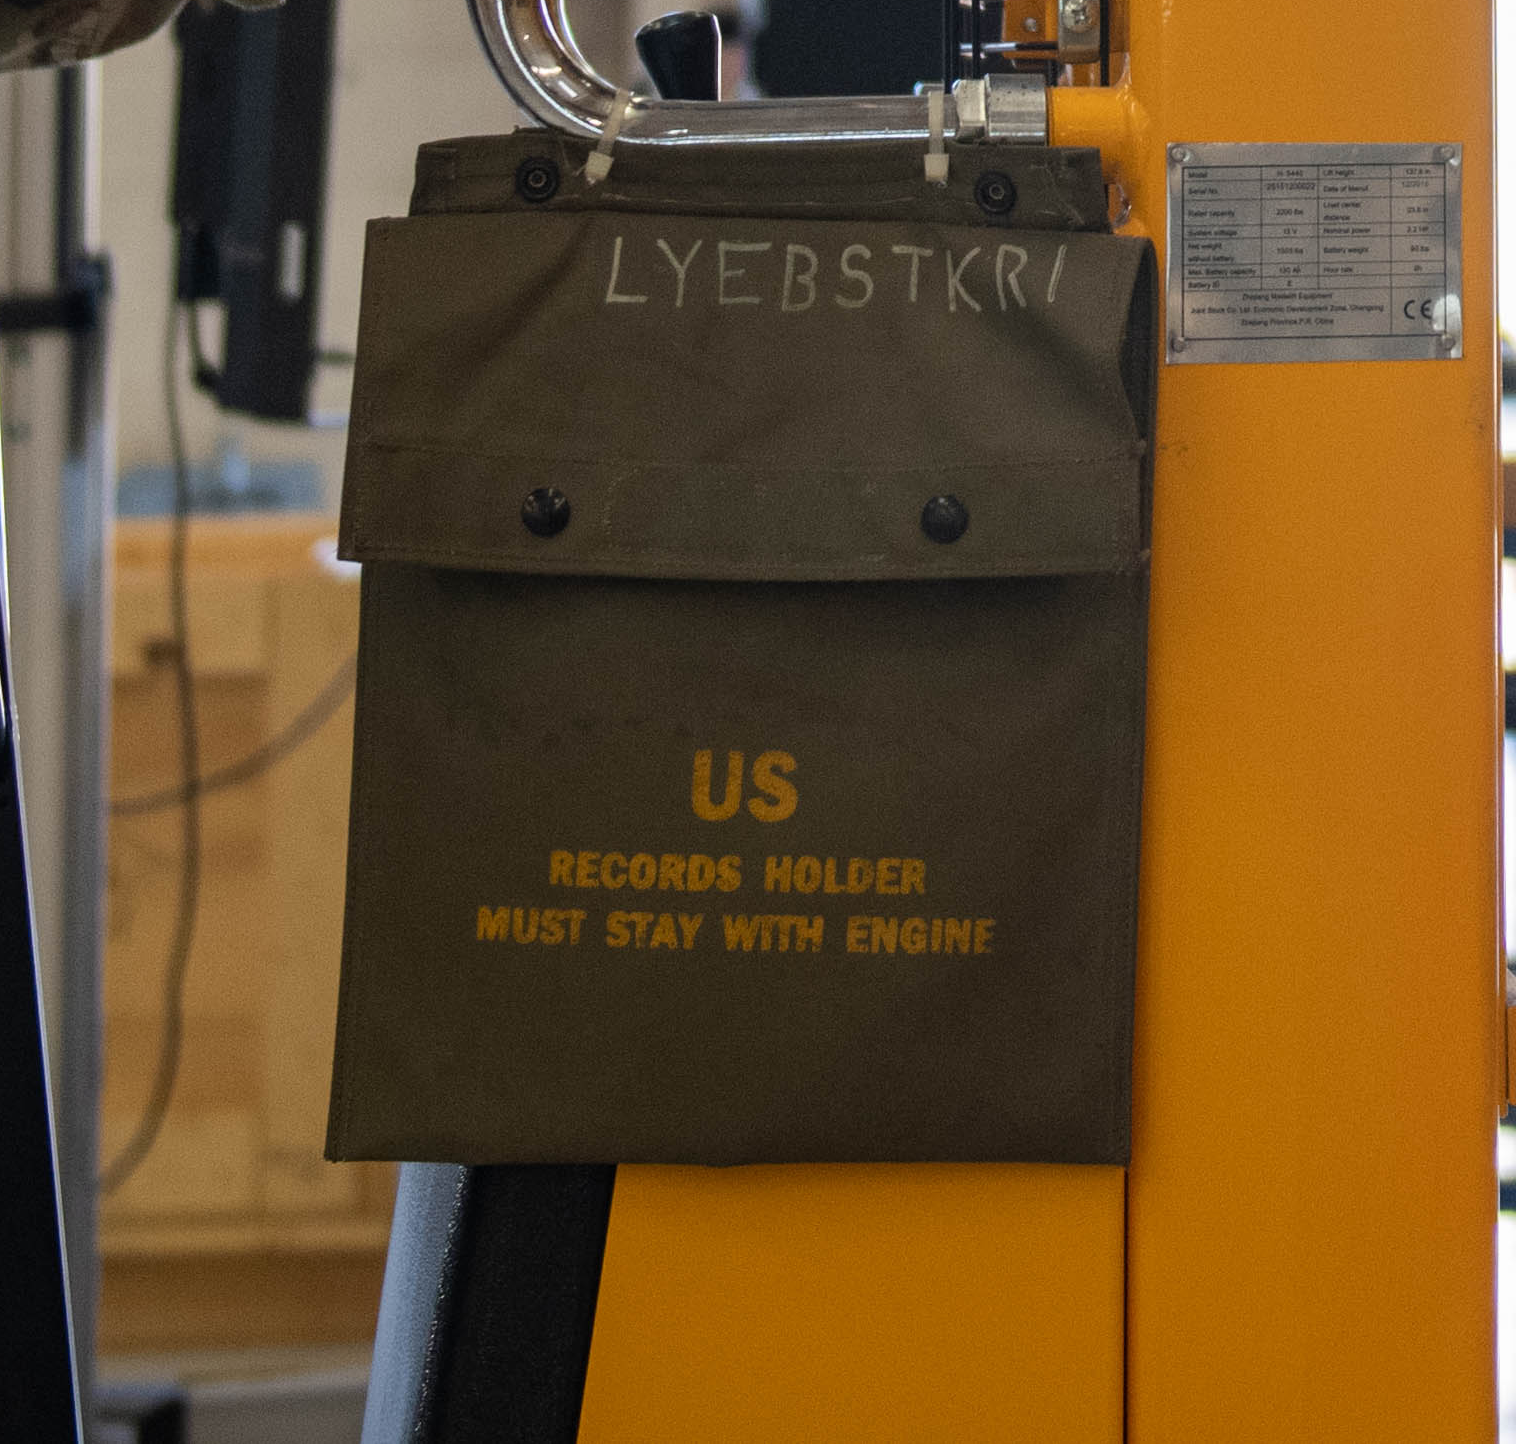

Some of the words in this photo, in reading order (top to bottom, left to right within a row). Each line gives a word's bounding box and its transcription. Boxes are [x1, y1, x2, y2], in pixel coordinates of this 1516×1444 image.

[691, 748, 799, 823] US
[549, 849, 743, 892] RECORDS
[764, 855, 926, 895] HOLDER
[476, 905, 586, 945] MUST
[605, 910, 705, 951] STAY
[722, 914, 825, 954] WITH
[845, 915, 997, 956] ENGINE
